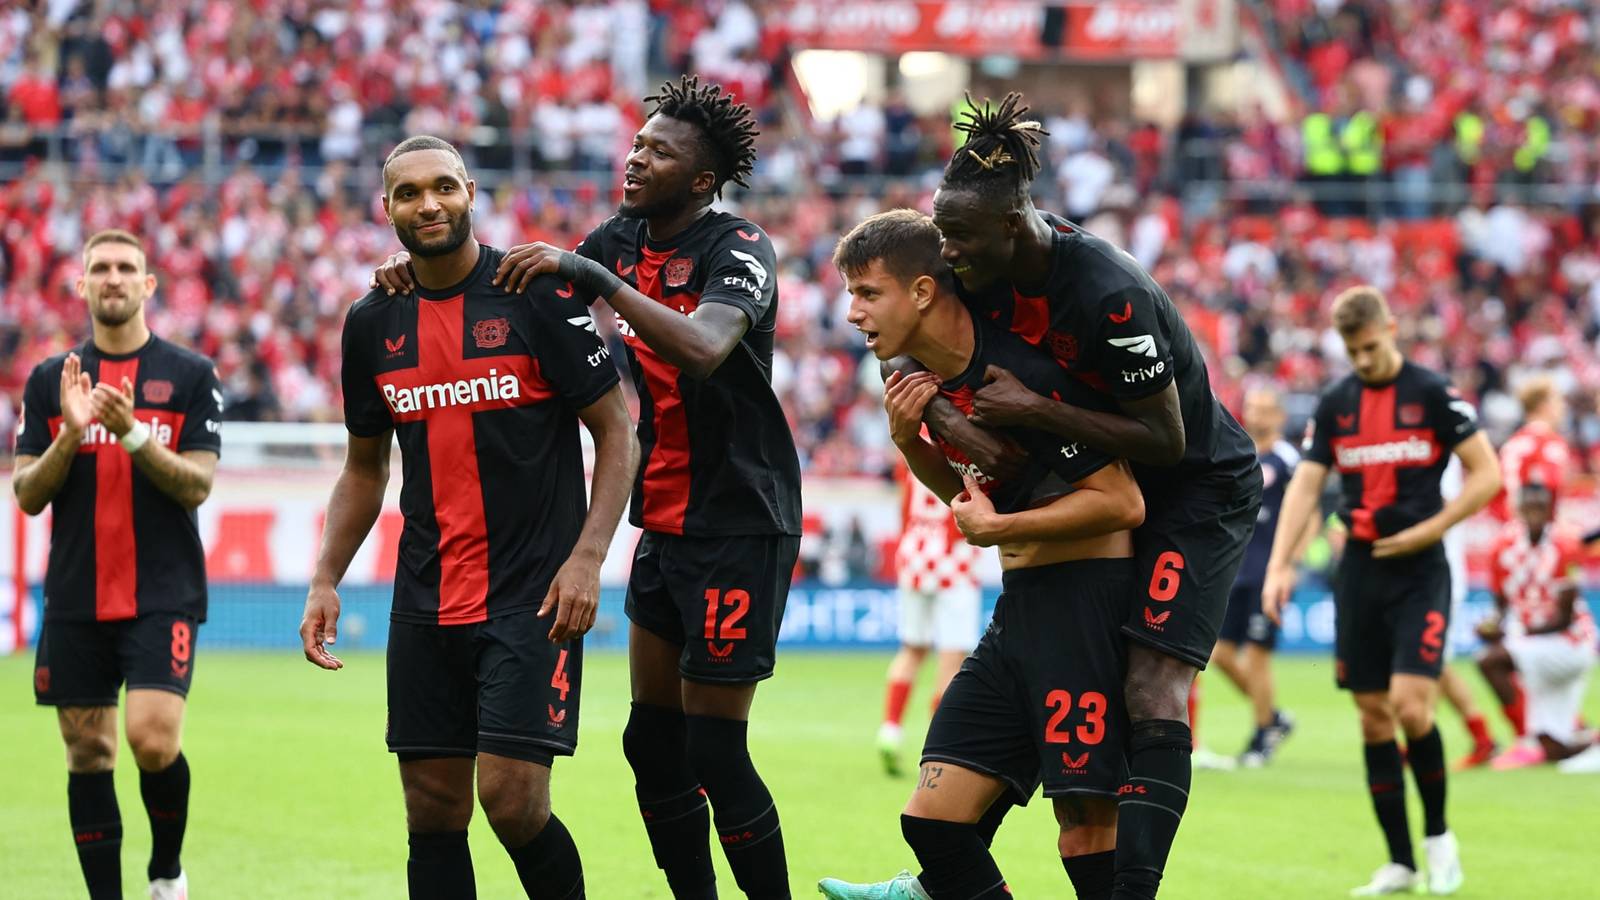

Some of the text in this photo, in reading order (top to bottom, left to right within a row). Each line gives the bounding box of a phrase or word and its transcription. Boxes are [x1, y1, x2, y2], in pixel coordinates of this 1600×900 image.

[723, 276, 762, 301] trive
[586, 345, 611, 368] triv
[1121, 360, 1165, 383] trive
[383, 368, 520, 414] Barmenia
[1148, 550, 1184, 602] 6
[703, 588, 750, 640] 12
[1421, 610, 1445, 647] 2
[171, 621, 191, 662] 8
[551, 648, 570, 701] 4
[1044, 688, 1107, 745] 23
